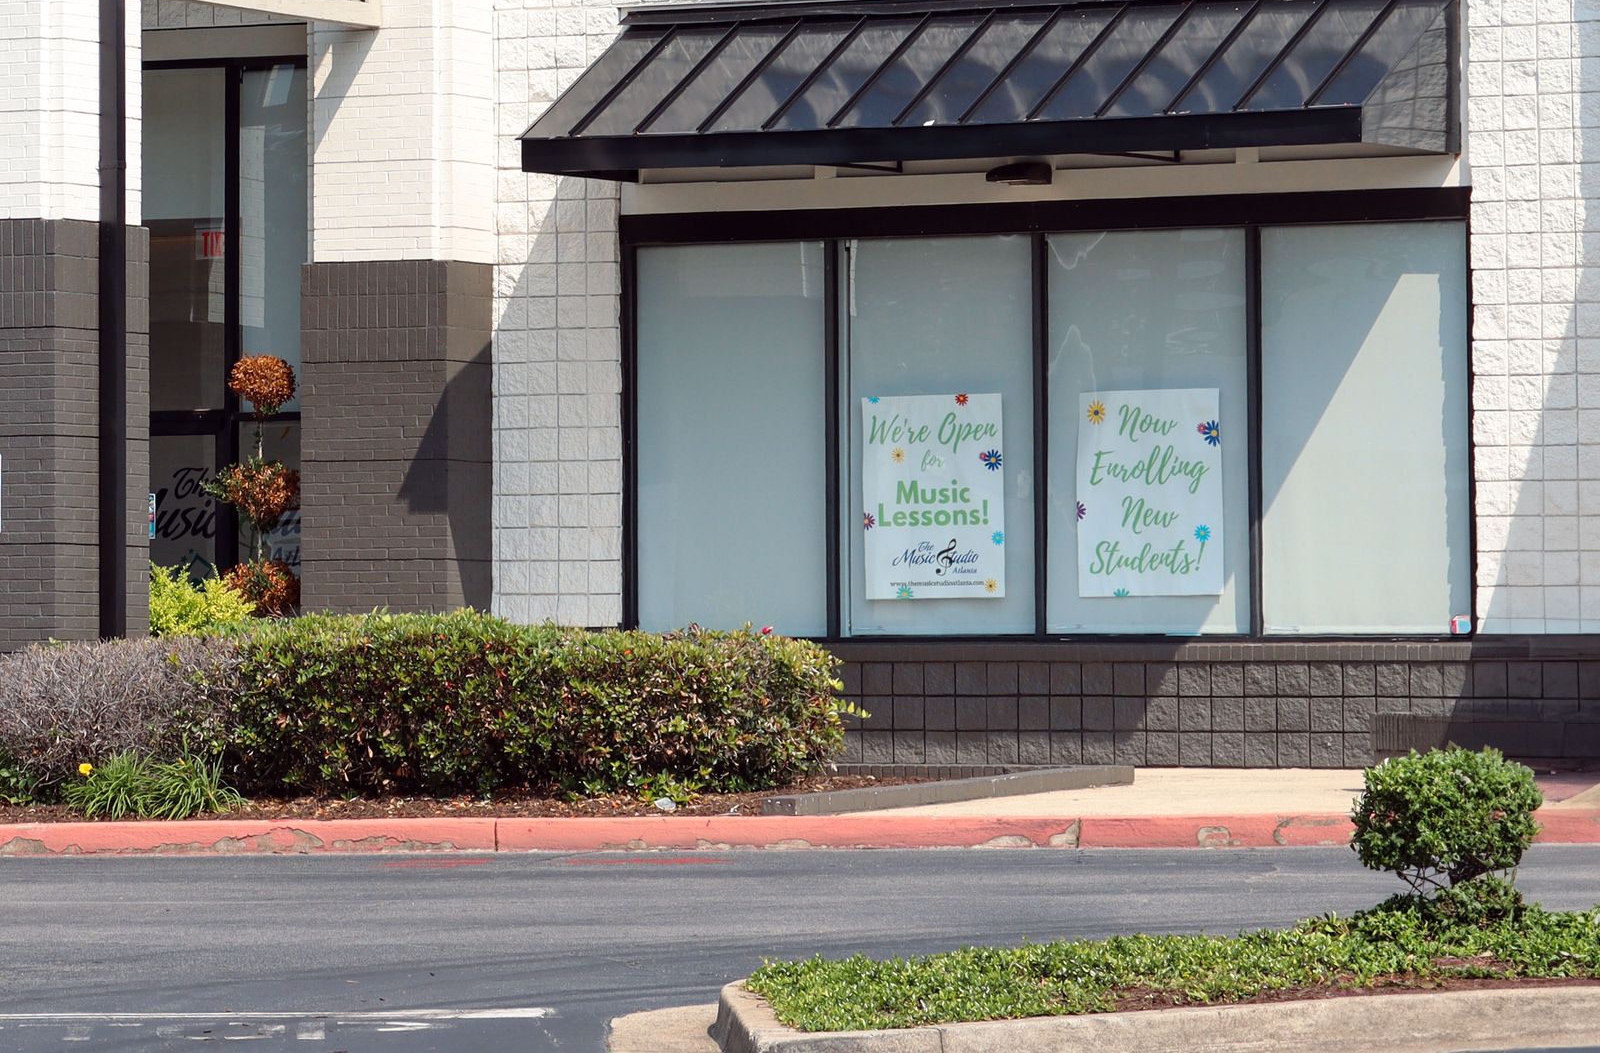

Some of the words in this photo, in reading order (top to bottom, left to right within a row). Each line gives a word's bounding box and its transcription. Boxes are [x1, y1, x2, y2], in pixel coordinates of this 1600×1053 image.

[869, 414, 930, 446] We're
[938, 411, 998, 453] Open
[1118, 404, 1177, 441] Now
[920, 449, 945, 471] for
[1089, 445, 1210, 494] Enrolling
[895, 479, 971, 505] Music
[878, 500, 990, 527] Lessons!
[1120, 495, 1179, 534] New
[892, 549, 936, 568] Music
[952, 566, 977, 574] Atlanta
[1089, 538, 1205, 576] Students!
